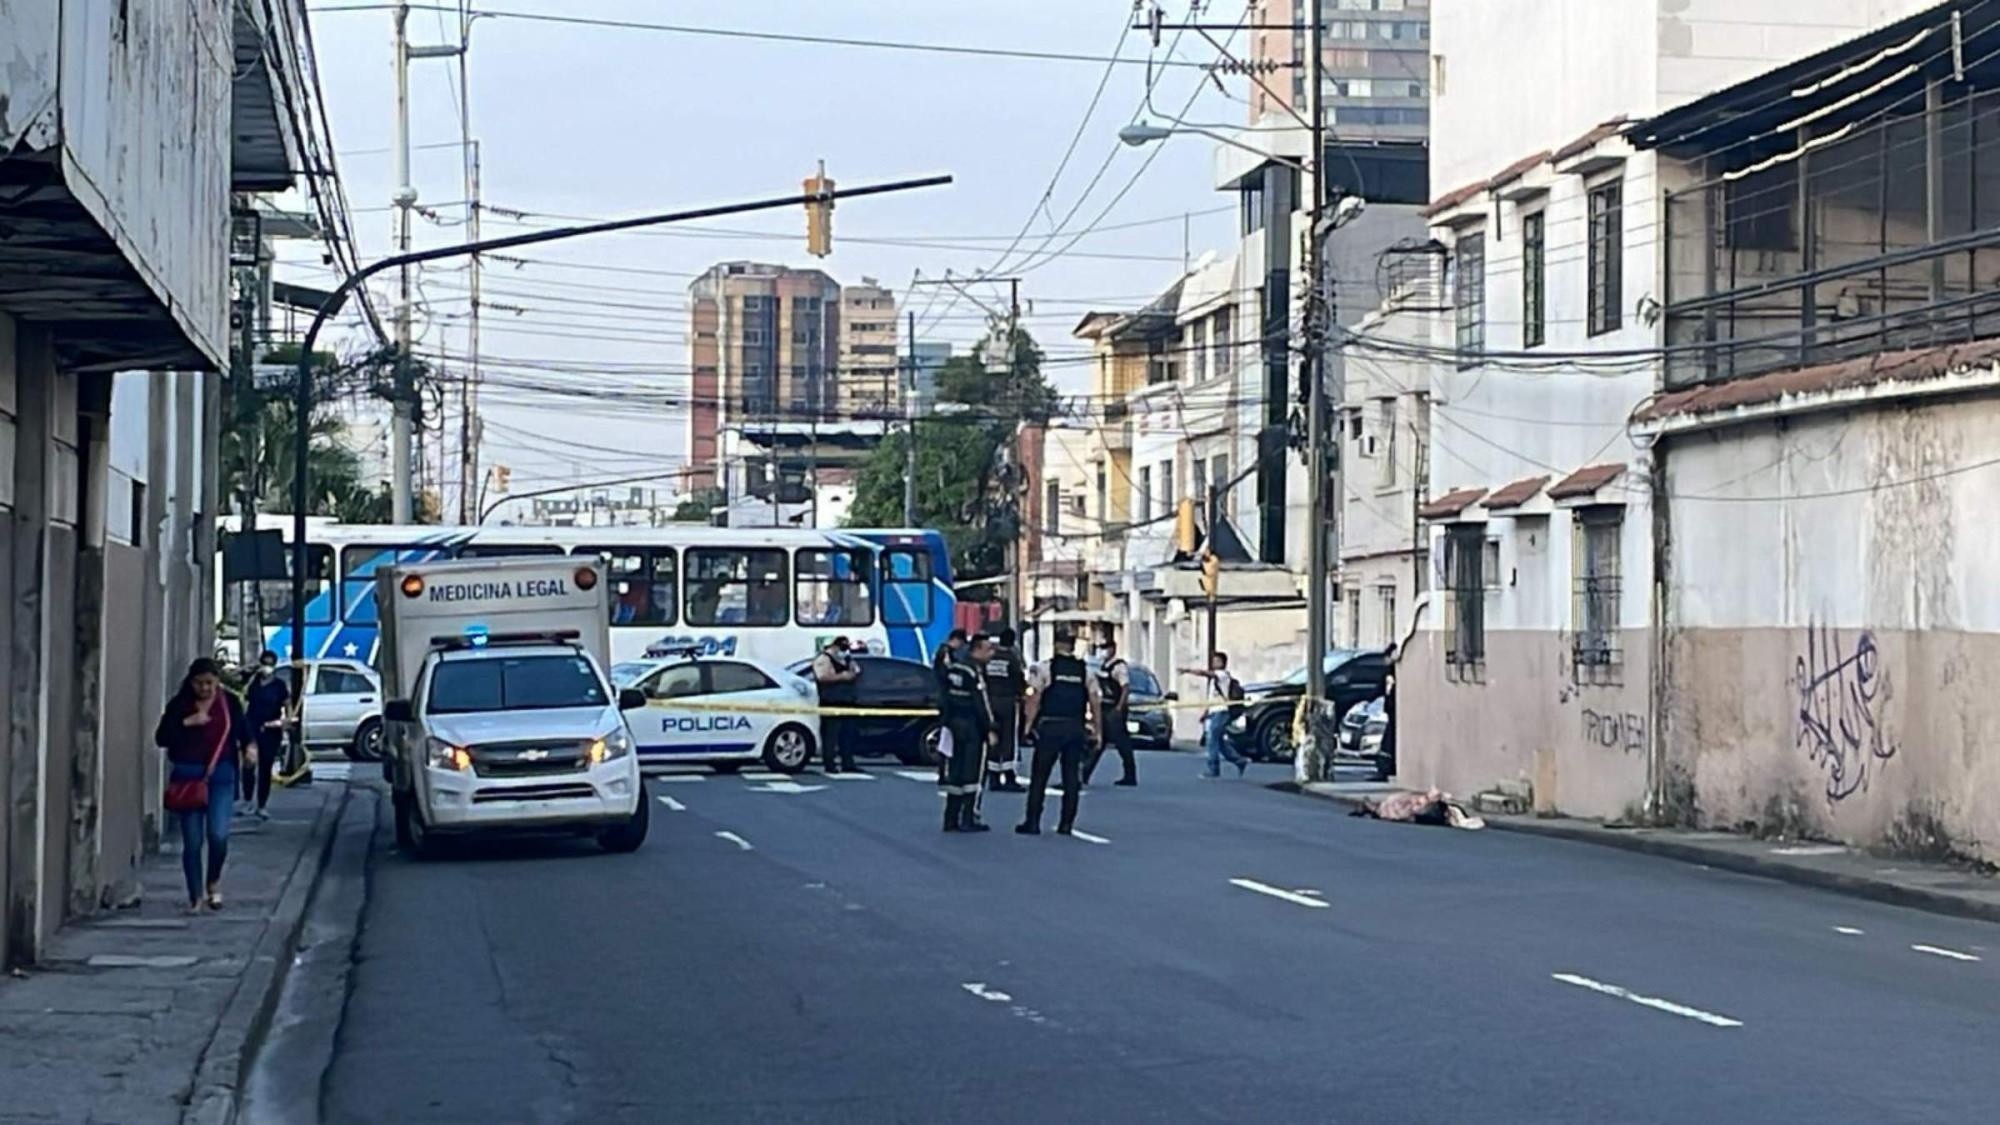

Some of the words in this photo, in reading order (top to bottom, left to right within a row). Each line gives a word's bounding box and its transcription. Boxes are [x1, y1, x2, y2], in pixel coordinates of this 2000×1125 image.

[429, 582, 511, 602] MEDICINA
[517, 579, 568, 598] LEGAL
[661, 715, 752, 733] POLICIA
